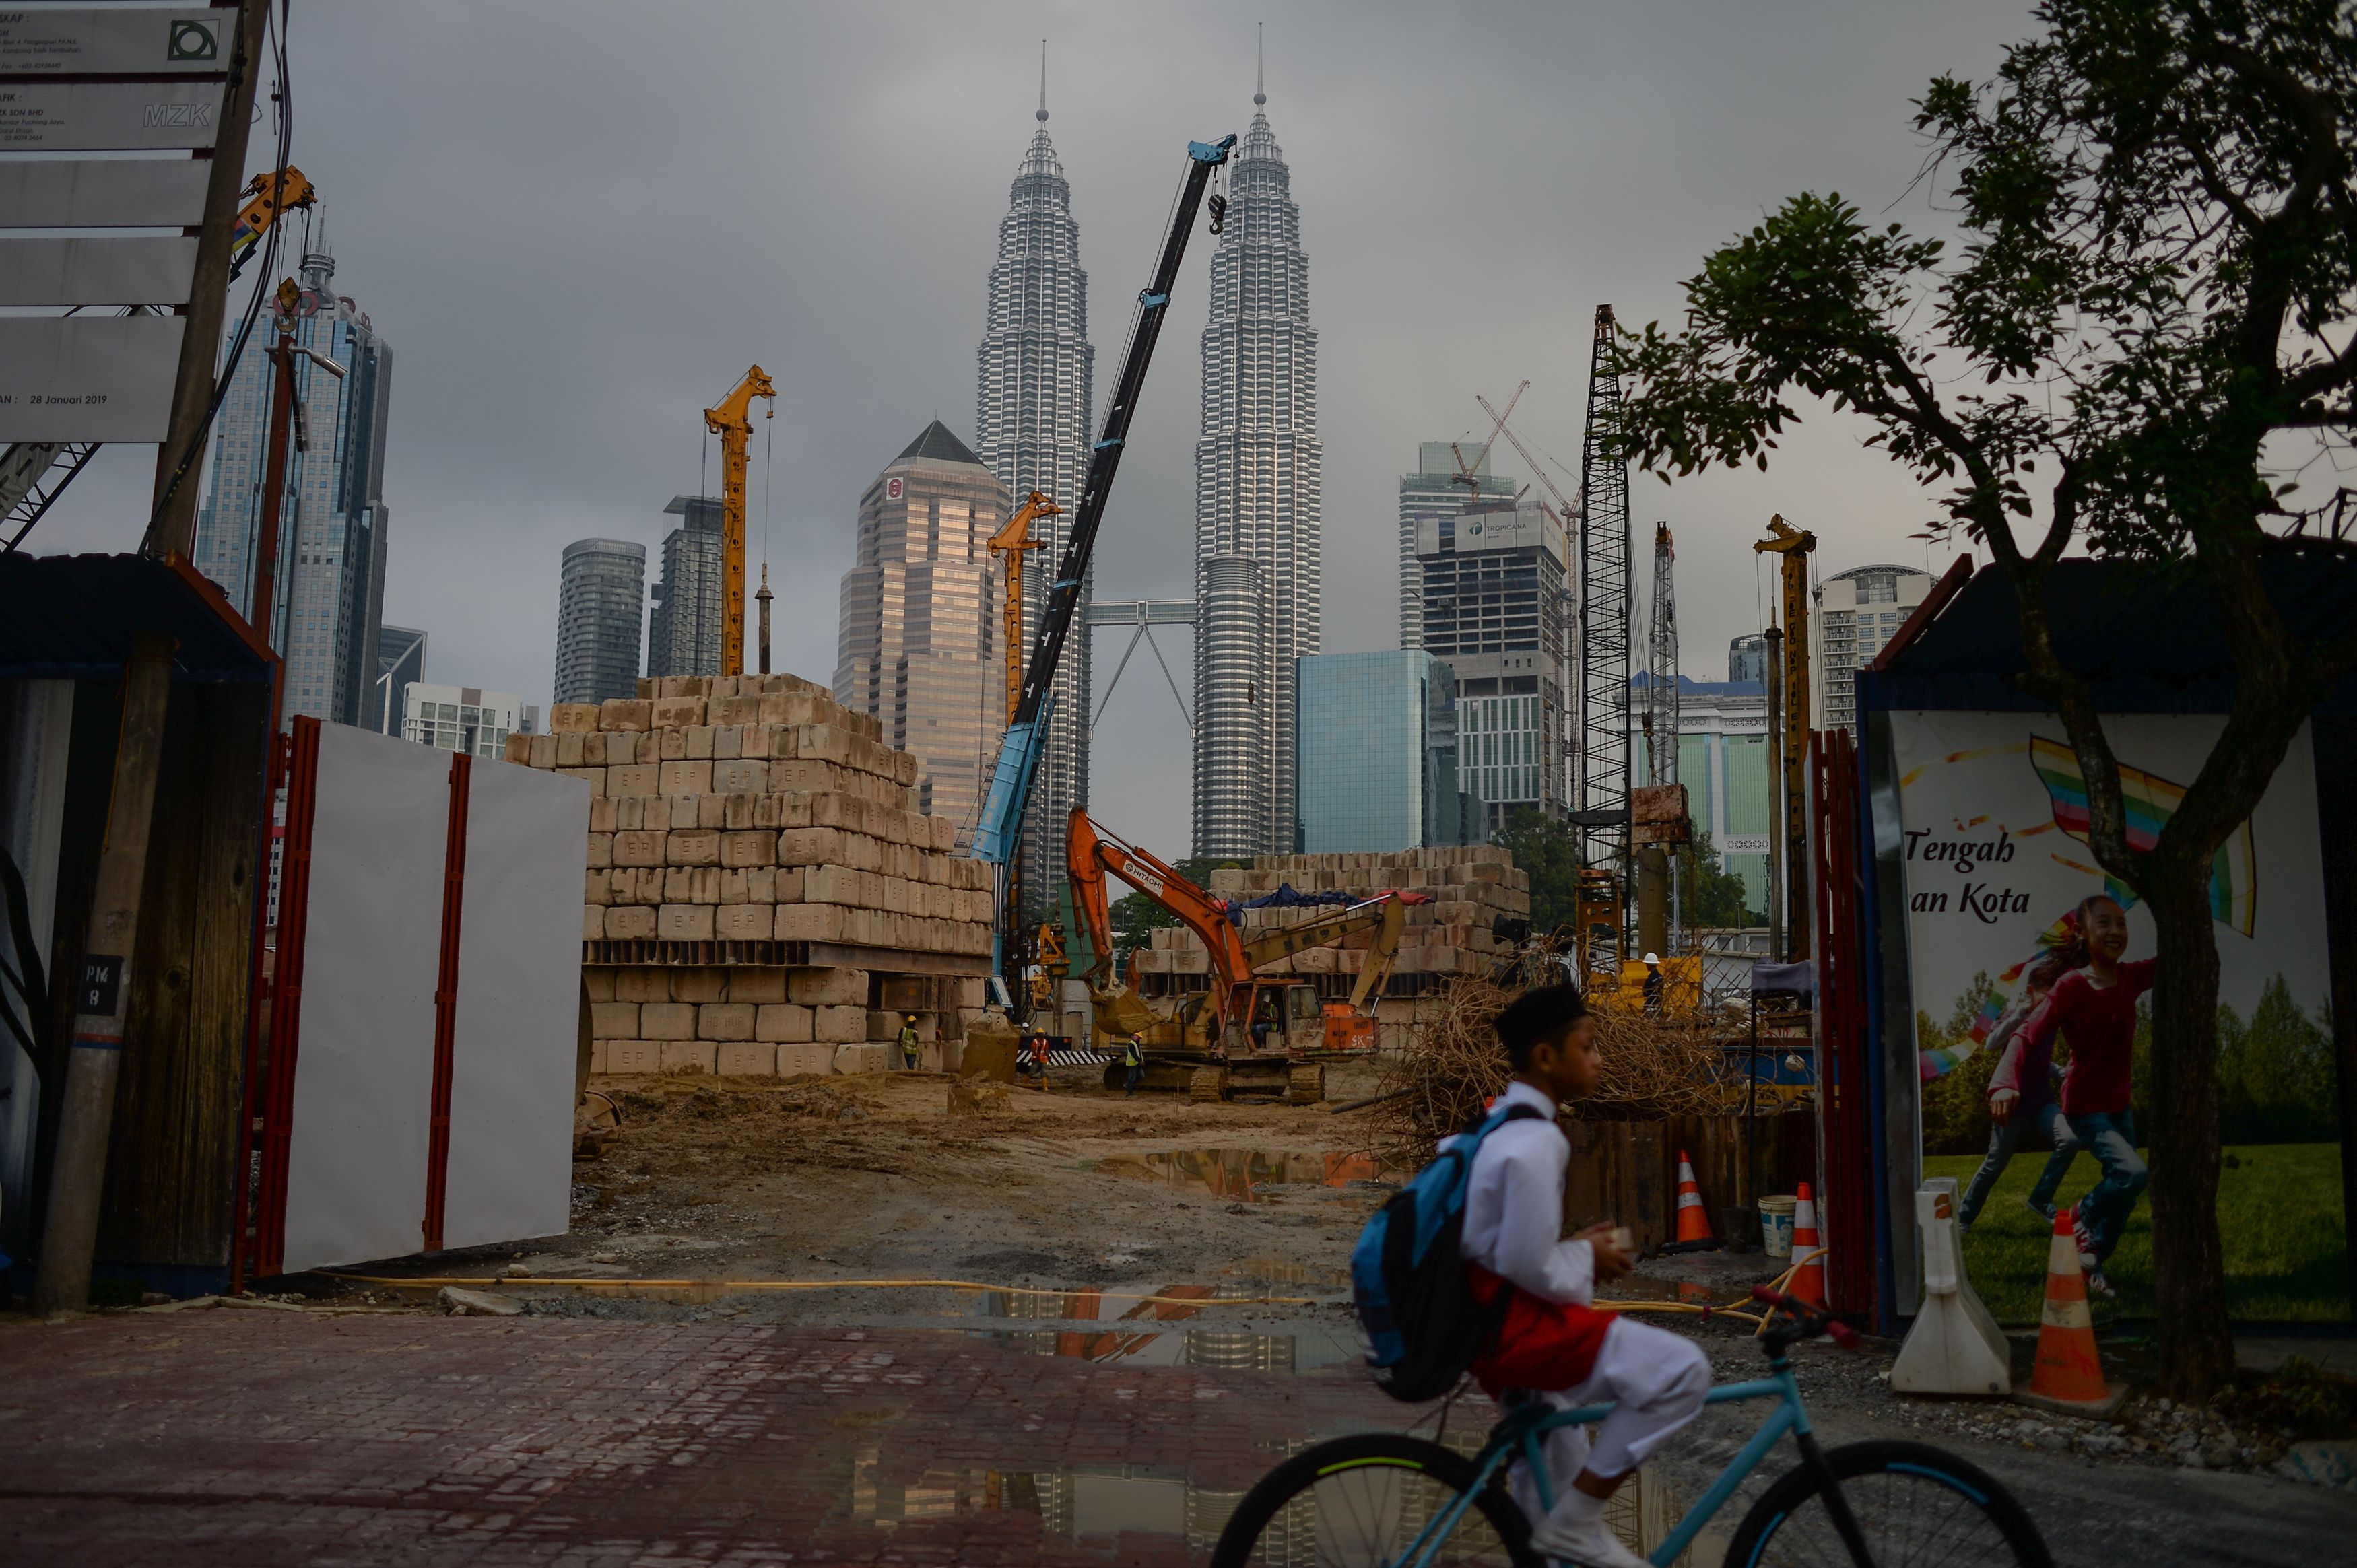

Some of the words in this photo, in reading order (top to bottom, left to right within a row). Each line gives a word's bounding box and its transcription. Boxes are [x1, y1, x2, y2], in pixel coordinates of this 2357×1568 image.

[143, 103, 212, 127] MZK
[30, 395, 42, 405] 28
[44, 395, 82, 405] Januari
[85, 395, 108, 405] 2019
[1486, 523, 1527, 532] TROPICANA
[1905, 828, 2015, 873] Tengah
[1133, 868, 1162, 889] HITACHI
[1959, 883, 2030, 924] Kota
[88, 989, 100, 1006] 8
